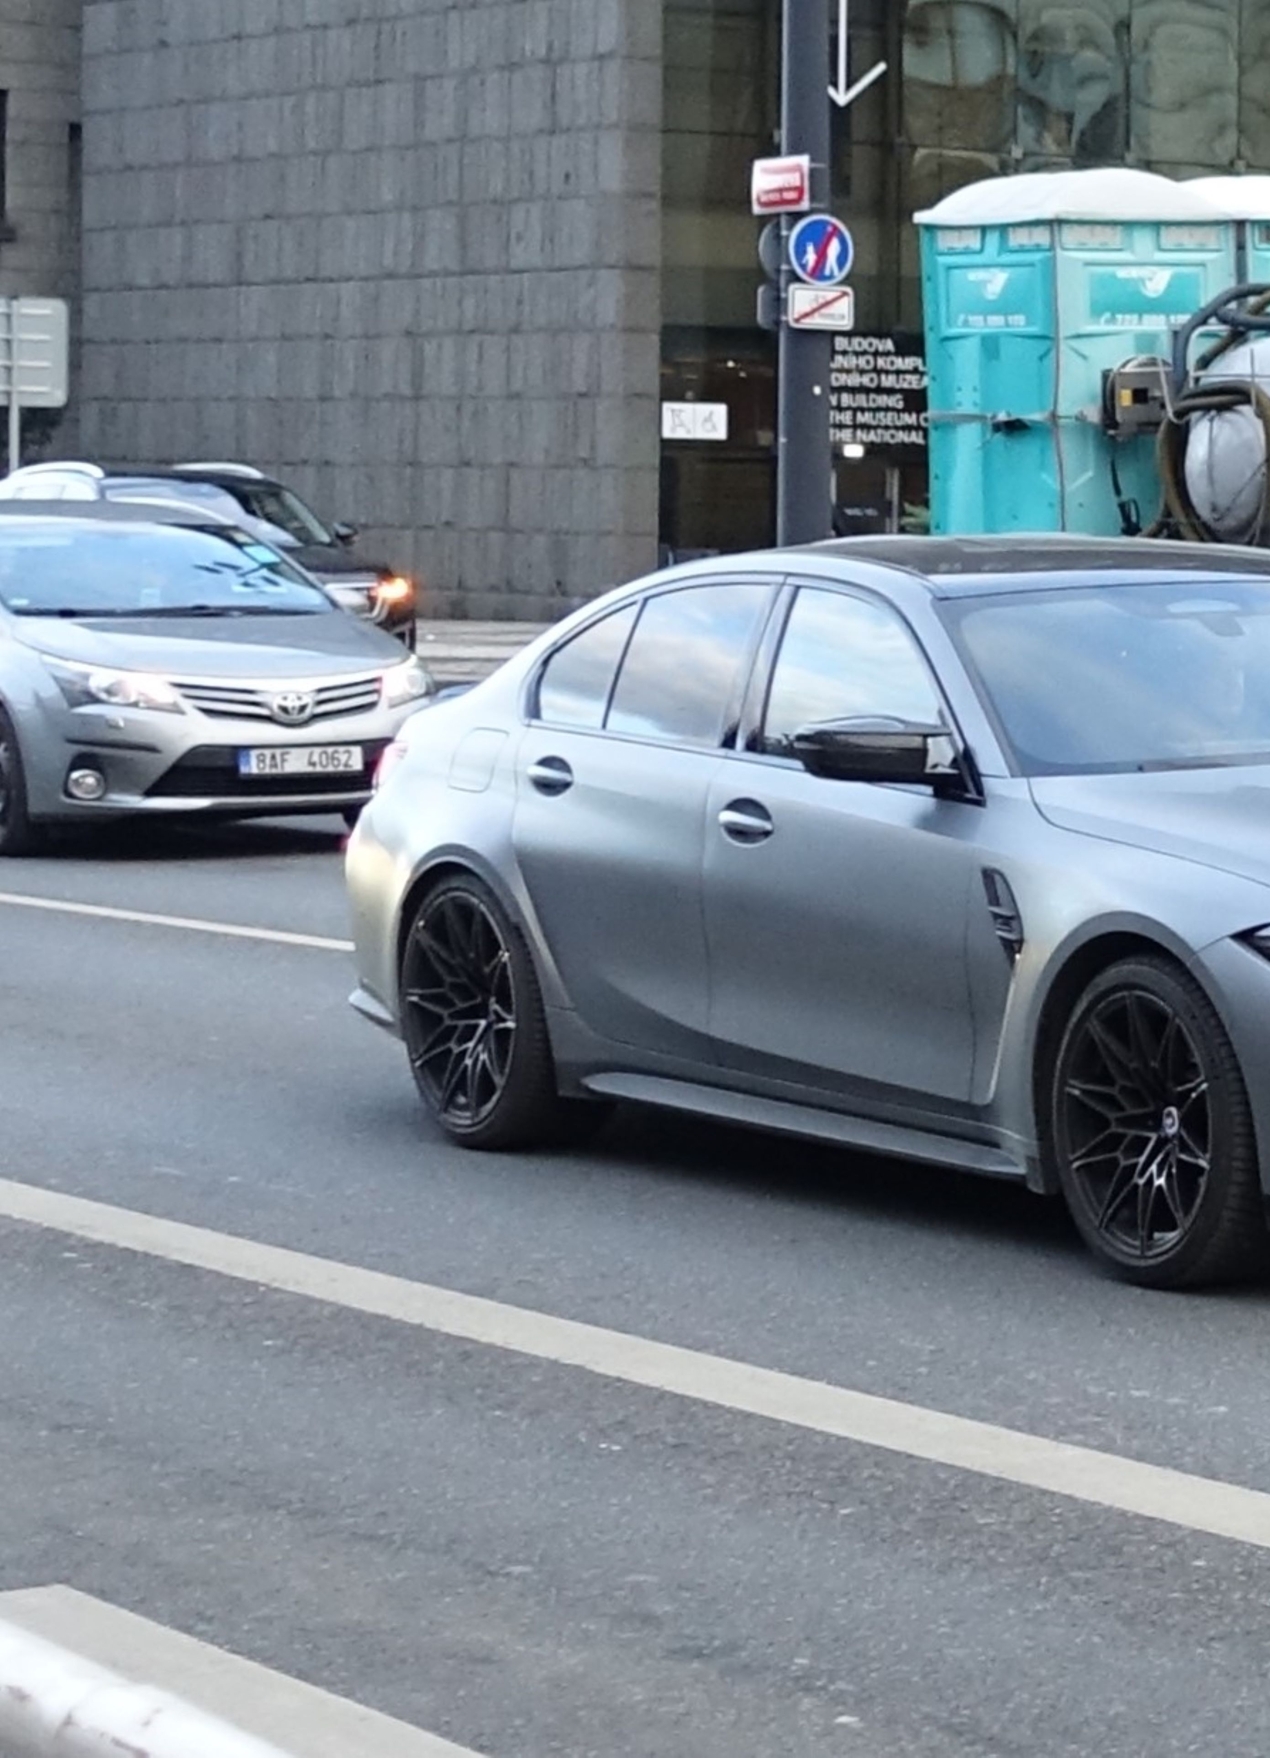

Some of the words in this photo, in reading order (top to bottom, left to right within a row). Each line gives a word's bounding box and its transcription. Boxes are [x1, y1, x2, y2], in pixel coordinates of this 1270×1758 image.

[834, 336, 895, 353] BUDOVA
[877, 356, 928, 371] KOMPL
[841, 393, 904, 409] BUILDING
[829, 410, 853, 425] THE
[856, 411, 917, 426] MUSEUM
[829, 427, 853, 442] THE
[856, 429, 926, 446] NATIONAL
[256, 751, 291, 772] 8AF
[307, 748, 354, 769] 4062
